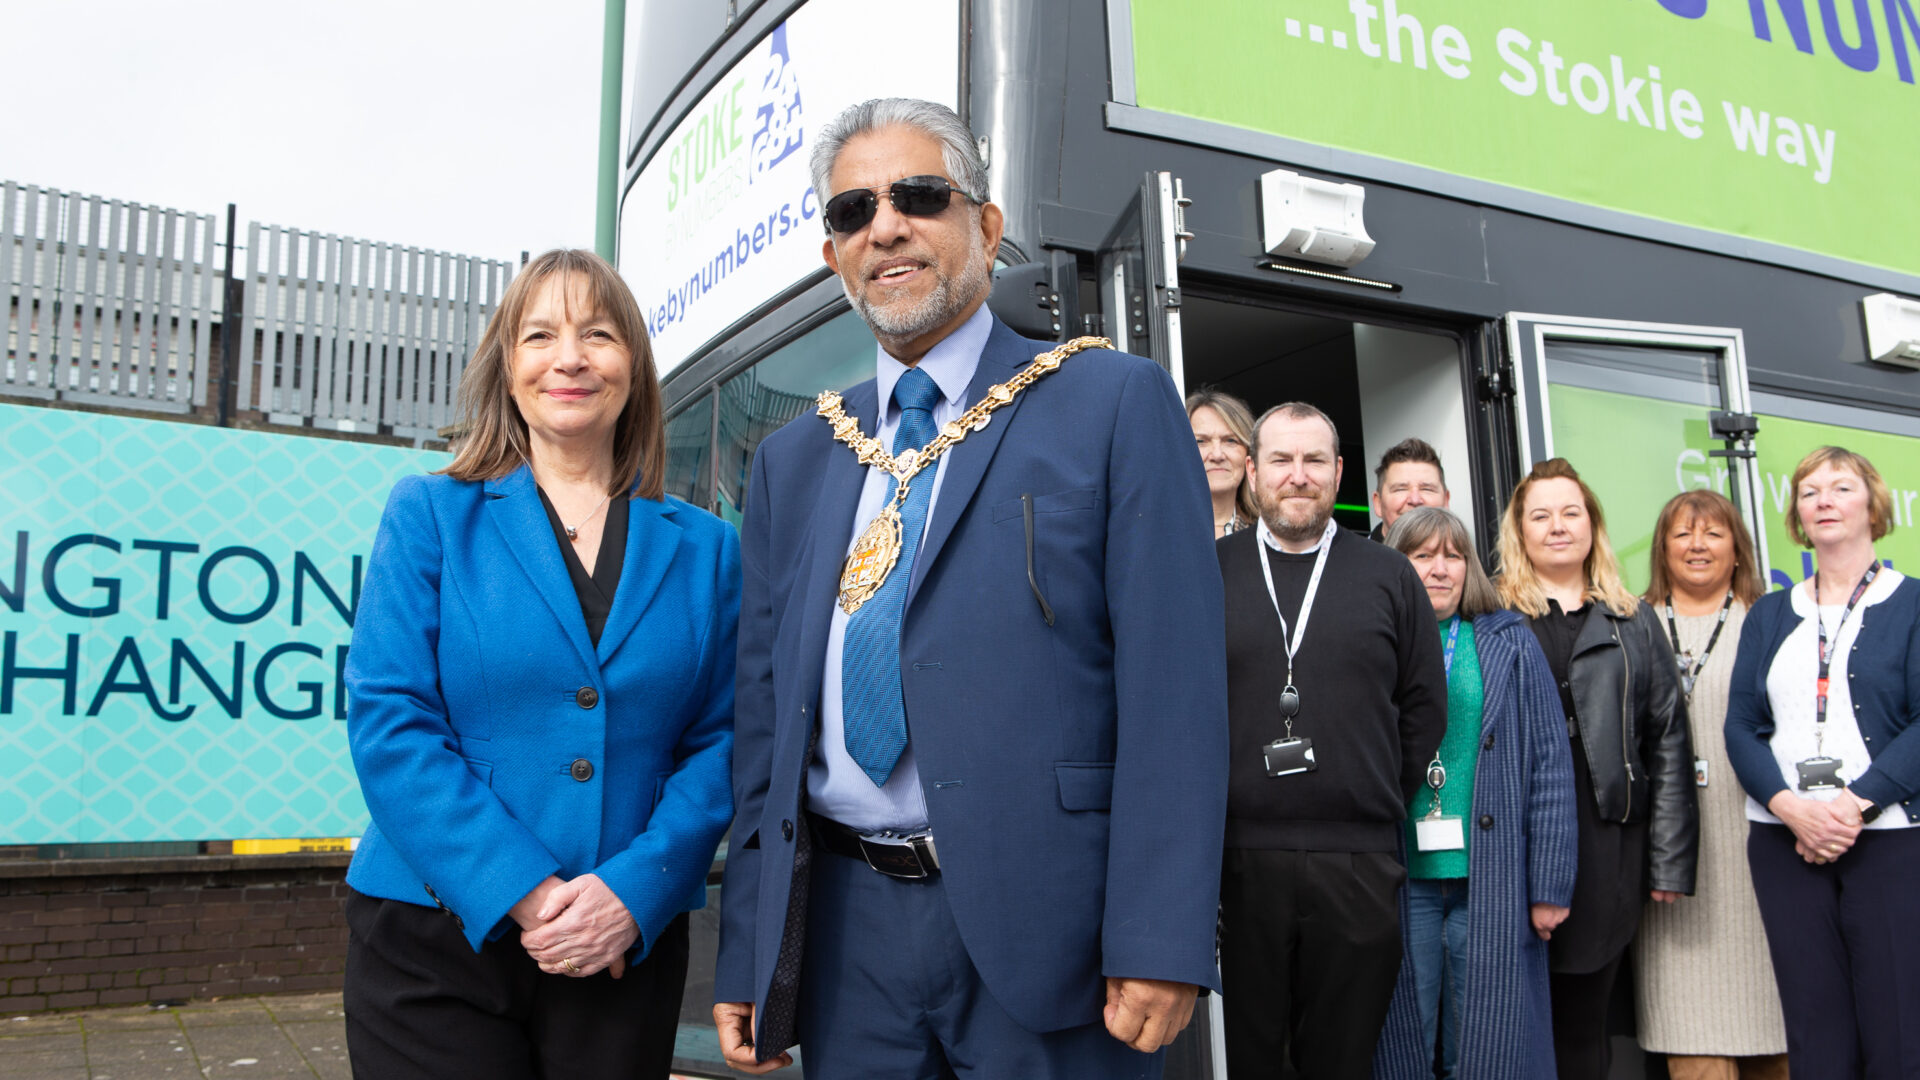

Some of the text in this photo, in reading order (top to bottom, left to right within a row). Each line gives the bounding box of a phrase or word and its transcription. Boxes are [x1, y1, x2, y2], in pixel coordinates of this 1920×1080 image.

[667, 77, 745, 213] STOKE
[1496, 27, 1704, 140] Stokie
[1722, 100, 1836, 185] way
[1676, 449, 1792, 514] Grw
